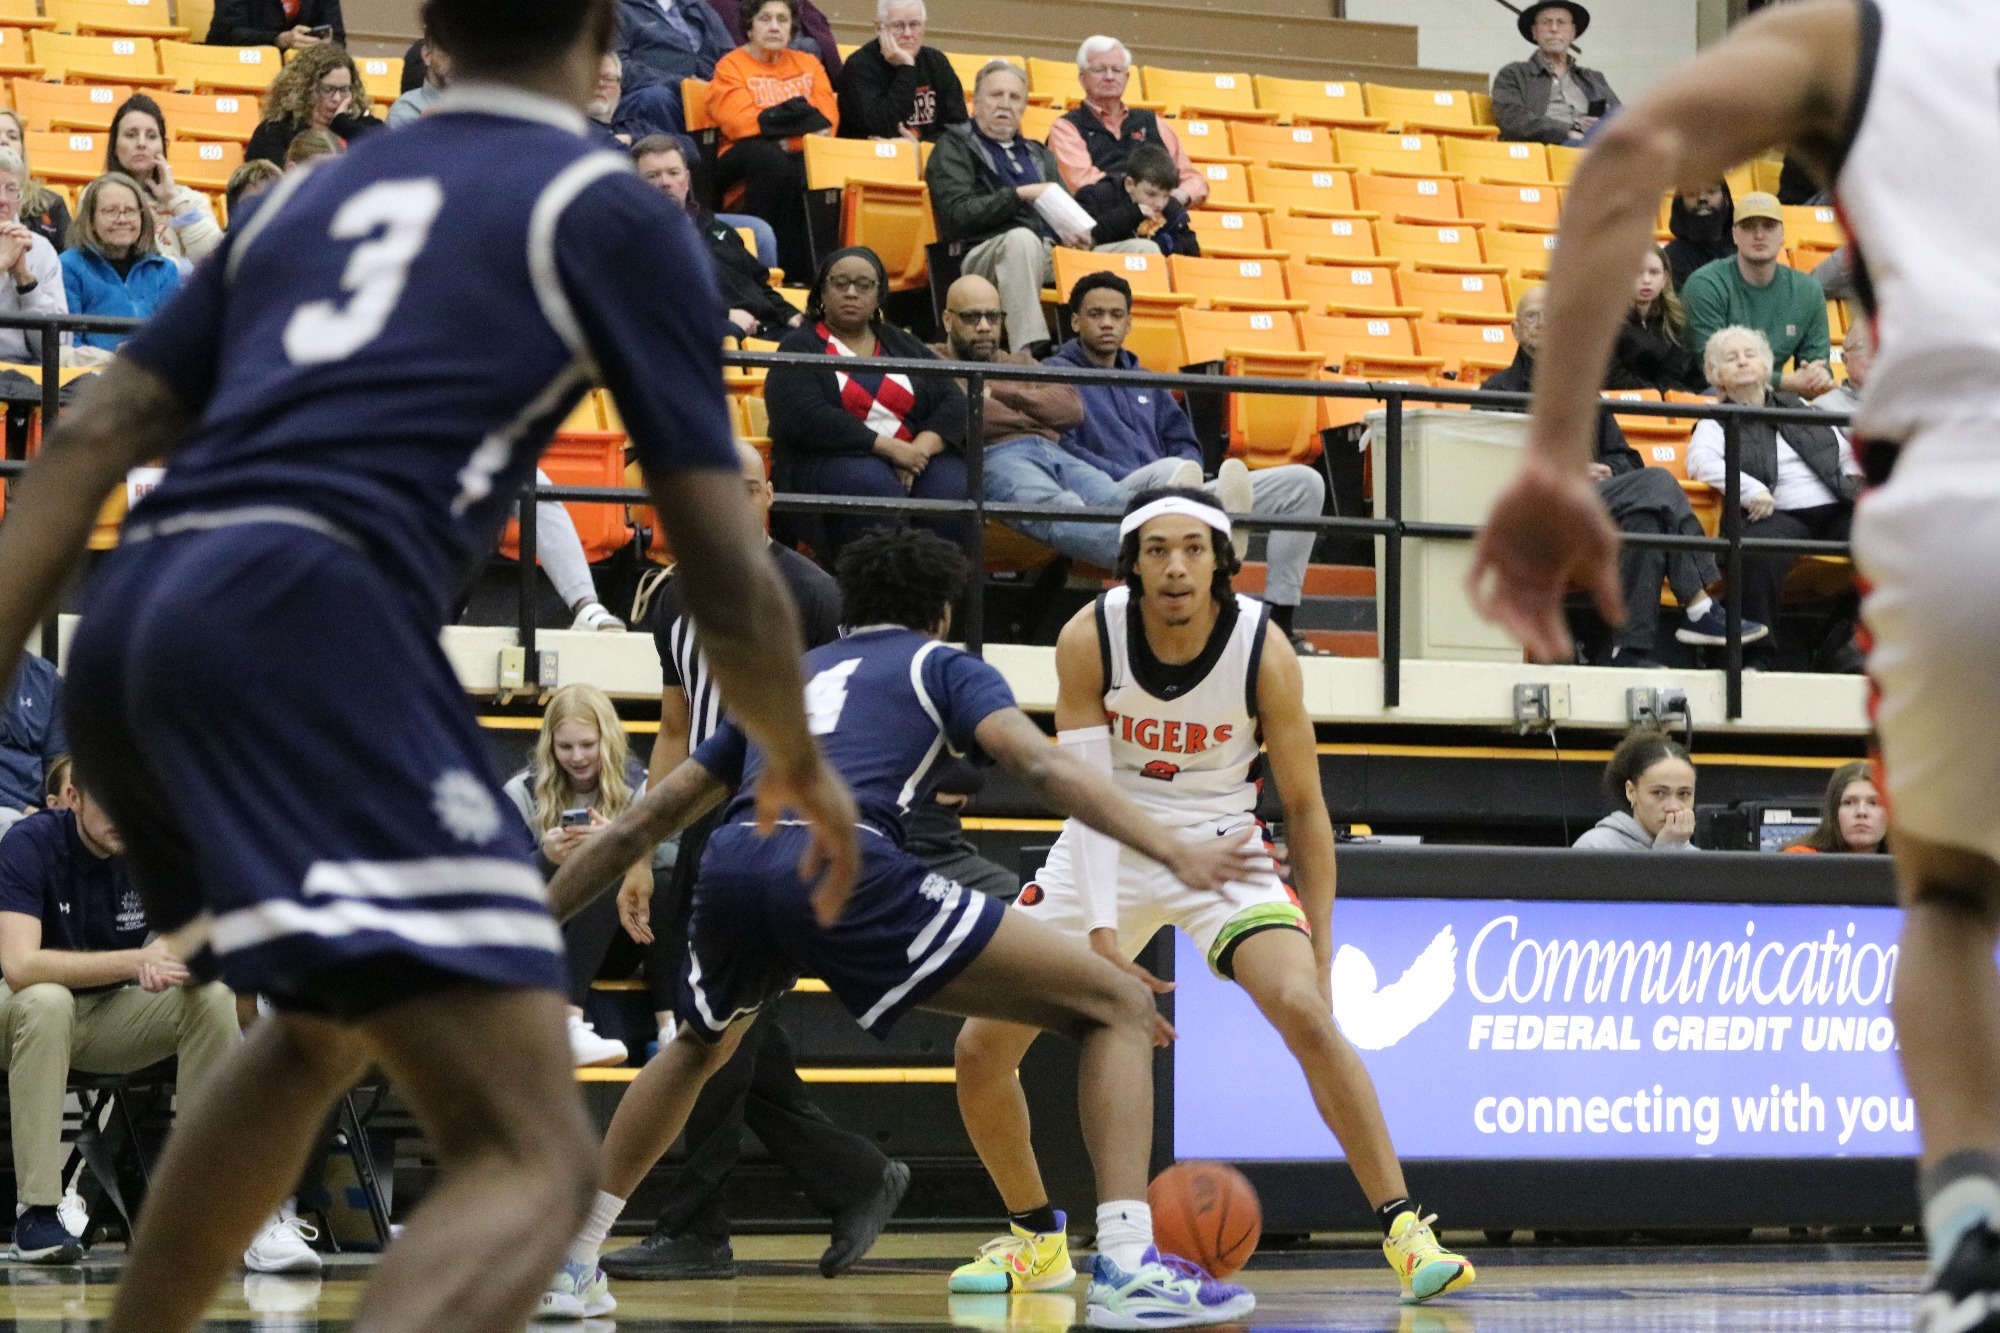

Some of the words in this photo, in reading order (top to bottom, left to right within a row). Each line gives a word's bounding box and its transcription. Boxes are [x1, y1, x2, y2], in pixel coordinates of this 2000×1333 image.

[284, 176, 443, 366] 3
[1106, 710, 1233, 754] TIGERS
[1468, 1015, 1641, 1051] FEDERAL
[1652, 1015, 1792, 1052] CREDIT
[1801, 1016, 1899, 1052] UNIO
[1474, 1083, 1720, 1145] connecting
[1732, 1082, 1825, 1132] with
[1836, 1095, 1914, 1145] you
